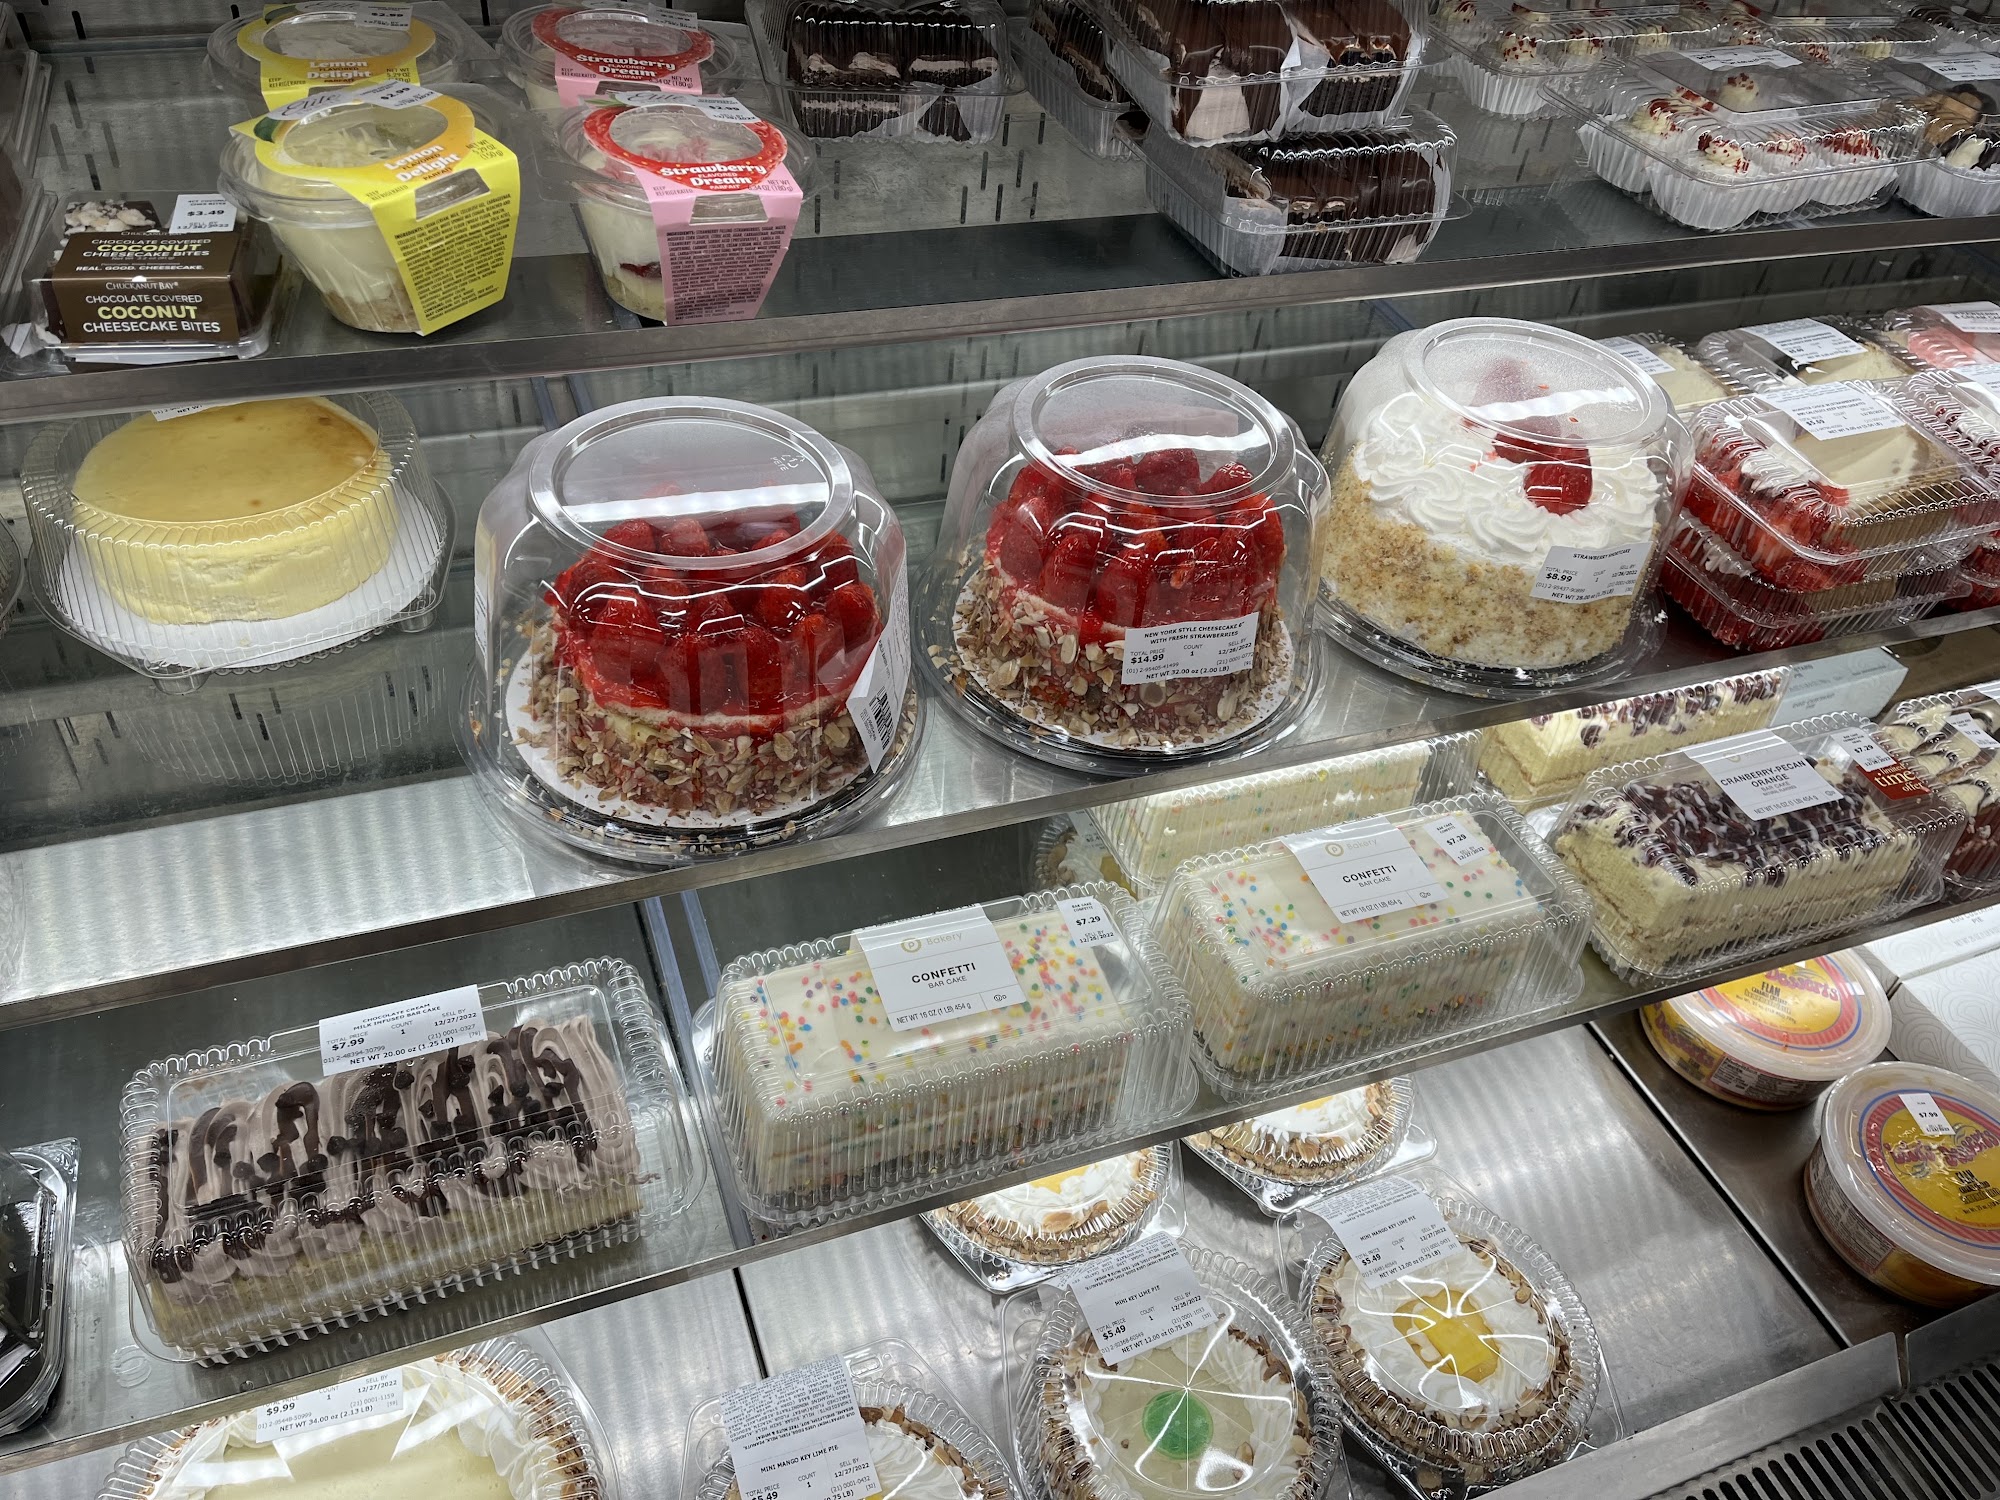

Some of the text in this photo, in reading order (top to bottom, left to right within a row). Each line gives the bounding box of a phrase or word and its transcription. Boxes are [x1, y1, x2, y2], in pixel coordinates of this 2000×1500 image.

[576, 54, 676, 70] Strawberry
[307, 71, 371, 80] Delight
[599, 65, 656, 77] Dream
[380, 87, 411, 100] $2.99
[384, 144, 444, 170] Lemon
[402, 153, 440, 170] FLAVORED
[395, 153, 461, 182] Delight
[660, 164, 767, 176] Strawberry
[691, 176, 752, 186] Dream
[106, 282, 157, 290] CHUCKANUT
[86, 295, 150, 303] CHOCOLATE
[98, 306, 197, 319] COCONUT
[83, 322, 220, 332] CHEESECAKE BITES
[1546, 573, 1572, 582] $8.99
[1190, 631, 1238, 639] STRAWBERRIES
[1131, 654, 1164, 665] $14.99
[1854, 745, 1874, 754] $7.29
[1721, 760, 1806, 785] CRANBERRY-PECAN
[1874, 770, 1916, 787] time
[1752, 774, 1790, 788] ORANGE
[1902, 782, 1924, 792] offer
[1347, 838, 1378, 850] Bakery
[1447, 834, 1466, 846] $7.29
[1342, 865, 1397, 883] CONFETTI
[1358, 876, 1391, 888] BAR CAKE
[1076, 916, 1100, 926] $7.29
[927, 932, 963, 946] Bakery
[911, 962, 977, 984] CONFETTI
[928, 975, 967, 989] BAR CAKE
[1761, 982, 1780, 997] FLAN
[353, 1006, 441, 1031] MILK INFUSED BAR CAKE
[363, 1003, 430, 1023] CHOCOLATE CREAM
[434, 1012, 477, 1027] 12/27/2022
[897, 1014, 908, 1025] NET
[909, 1013, 918, 1023] WT
[928, 1009, 937, 1019] OZ
[955, 1003, 966, 1013] 454
[967, 1002, 972, 1011] g
[391, 1020, 413, 1030] COUNT
[327, 1031, 368, 1045] TOTAL PRICE
[332, 1037, 365, 1051] $7.99
[350, 1057, 366, 1065] NET
[368, 1053, 381, 1062] WT
[383, 1048, 406, 1059] 20.00
[418, 1041, 438, 1052] (1.25
[440, 1036, 454, 1046] LB)
[1371, 1227, 1388, 1237] MANGO
[1392, 1237, 1406, 1246] COUNT
[1362, 1253, 1381, 1266] $5.49
[1379, 1261, 1412, 1278] NET WT 12.00
[1128, 1295, 1138, 1303] KEY
[1139, 1289, 1151, 1298] LIME
[1151, 1285, 1160, 1293] PIE
[1140, 1306, 1155, 1316] COUNT
[1096, 1317, 1126, 1333] TOTAL PRICE
[1102, 1325, 1126, 1341] $5.49
[1145, 1333, 1160, 1344] 12.00
[380, 1374, 388, 1382] BY
[358, 1380, 397, 1394] 12/27/2022
[266, 1402, 295, 1416] $9.99
[279, 1424, 293, 1433] NET
[295, 1420, 307, 1428] WT
[308, 1416, 329, 1426] 34.00
[340, 1409, 360, 1418] (2.13
[361, 1405, 373, 1413] LB)
[760, 1444, 839, 1473] MINI MANGO KEY LIME PIE
[839, 1459, 852, 1468] SELL
[797, 1471, 816, 1482] COUNT
[834, 1462, 870, 1478] 12/27/2022
[745, 1483, 780, 1497] TOTAL PRICE
